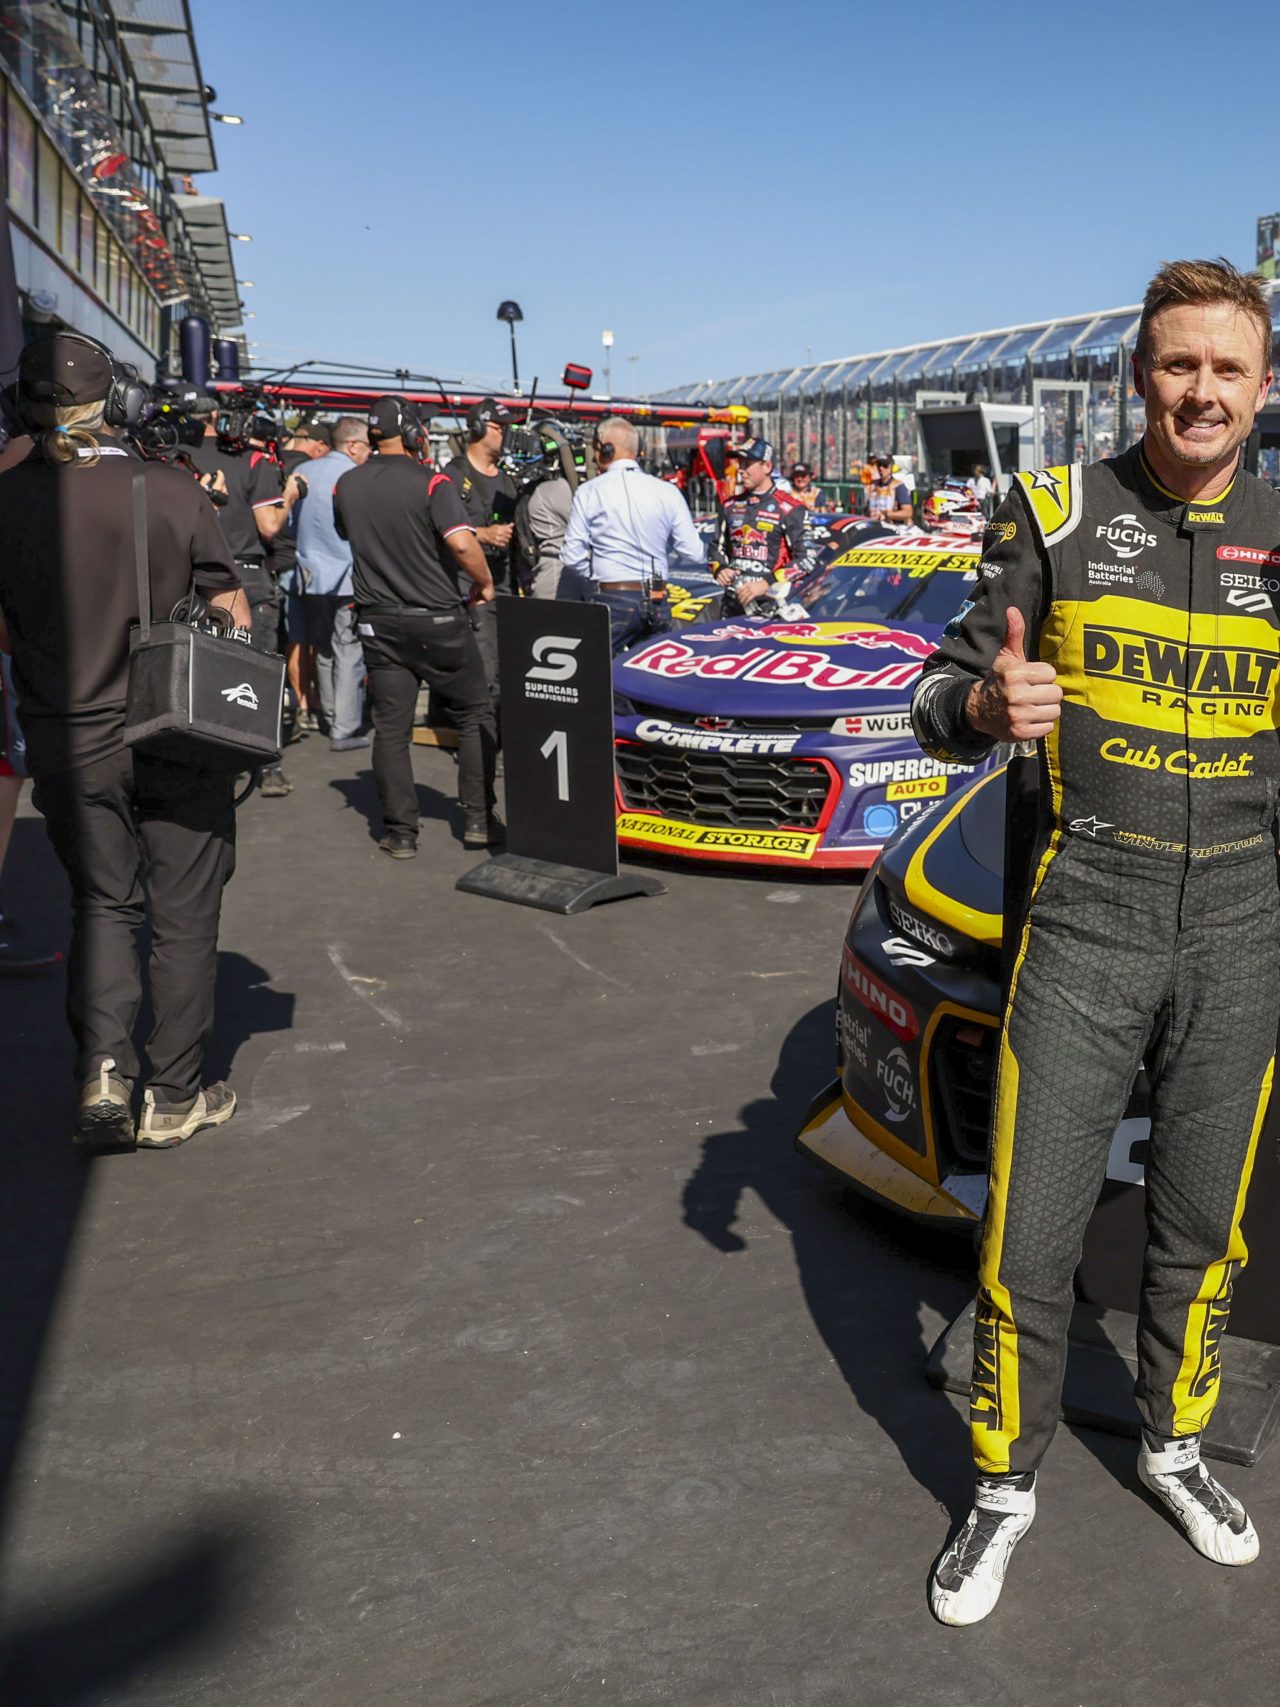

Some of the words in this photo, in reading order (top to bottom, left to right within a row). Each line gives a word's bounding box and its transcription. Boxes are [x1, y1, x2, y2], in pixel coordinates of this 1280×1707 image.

[1096, 525, 1157, 547] FUCHS
[838, 552, 937, 566] NATIONAL
[1088, 561, 1136, 575] Industrial
[1088, 570, 1134, 584] Batteries
[1220, 573, 1280, 592] SEIKO
[624, 640, 762, 680] Red
[744, 648, 923, 690] Bull
[525, 682, 578, 696] SUPERCARS
[525, 691, 578, 704] CHAMPIONSHIP
[1142, 690, 1265, 716] RACING
[867, 715, 913, 731] WÜR
[540, 730, 569, 801] 1
[1100, 738, 1161, 770] Cub
[1164, 749, 1253, 778] Cadet
[893, 782, 940, 796] AUTO
[616, 818, 697, 841] NATIONAL
[703, 832, 807, 851] STORAGE
[1119, 830, 1156, 842] MARK
[889, 902, 954, 957] SEIKO
[848, 964, 907, 1027] HINO
[876, 1058, 917, 1109] FUCH
